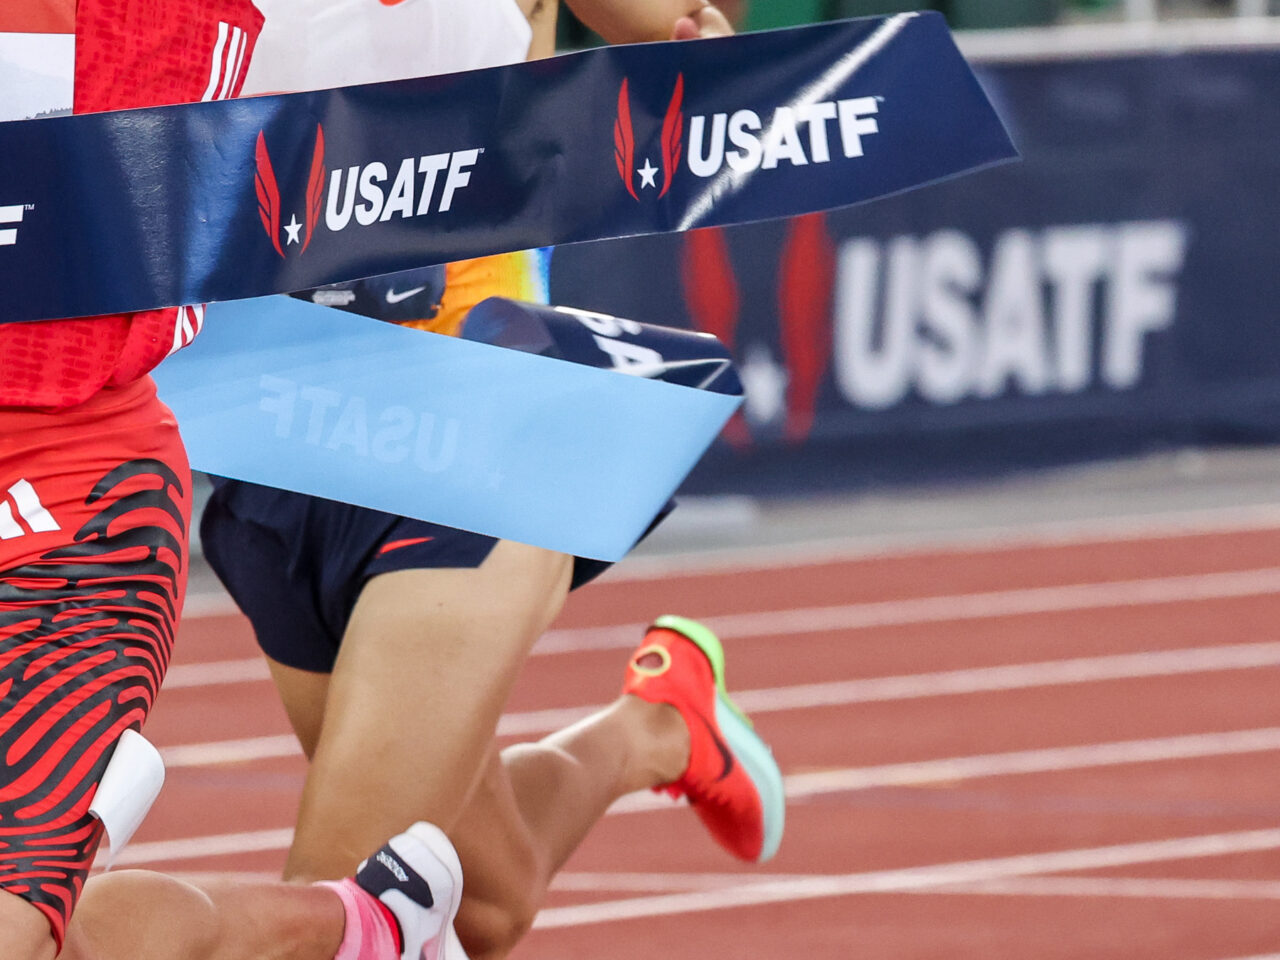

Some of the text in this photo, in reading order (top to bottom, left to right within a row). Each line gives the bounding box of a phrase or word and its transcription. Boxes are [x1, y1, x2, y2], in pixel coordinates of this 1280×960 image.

[687, 96, 879, 177] USATF
[325, 148, 480, 232] USATF
[834, 220, 1188, 410] USATF
